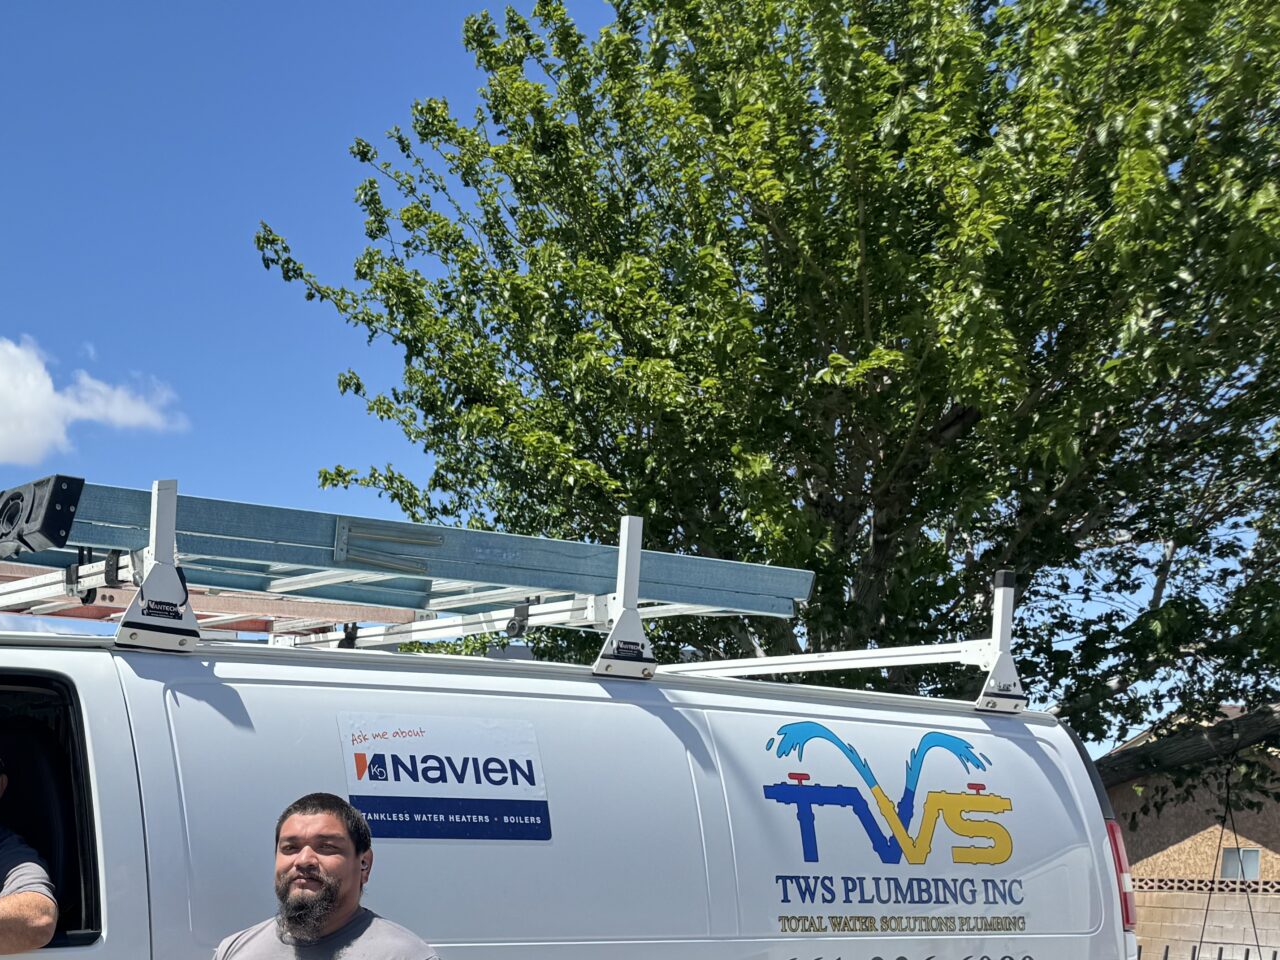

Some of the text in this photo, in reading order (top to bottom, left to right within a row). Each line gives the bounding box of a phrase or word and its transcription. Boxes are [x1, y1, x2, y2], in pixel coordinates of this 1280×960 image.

[351, 727, 426, 746] Ask me about
[361, 812, 542, 825] TANKLESS WATER HEATERS BOILERS
[763, 773, 1013, 865] TWS
[775, 875, 1025, 906] TWS PLUMBING INC
[778, 915, 1026, 933] TOTAL WATER SOLUTIONS PLUMBING
